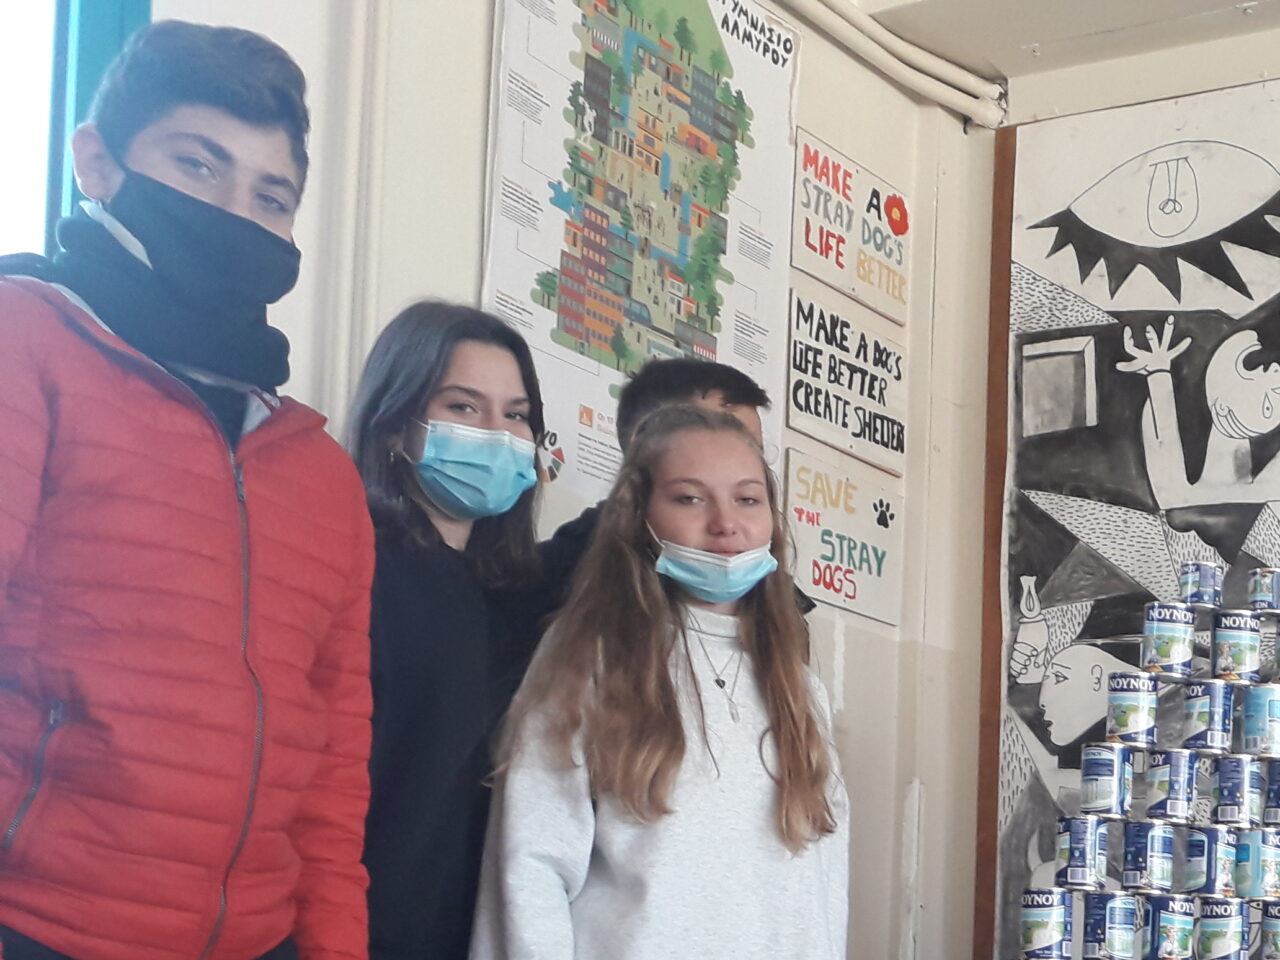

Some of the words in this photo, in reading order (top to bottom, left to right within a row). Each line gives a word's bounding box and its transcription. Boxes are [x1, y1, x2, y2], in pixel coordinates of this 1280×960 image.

[721, 12, 789, 68] ΑΛΜΥΡΟΥ
[802, 143, 853, 202] MAKE
[866, 188, 882, 221] A
[800, 177, 855, 233] STRAY
[862, 216, 904, 266] DOG'S
[804, 216, 846, 269] LIFE
[856, 248, 907, 305] BETTER
[796, 296, 850, 353] MAKE
[855, 332, 868, 363] A
[828, 354, 887, 407] BETTER
[792, 378, 851, 429] CREATE
[851, 406, 905, 454] SHELTER
[796, 466, 858, 515] SAVE
[793, 507, 822, 527] THE
[820, 528, 887, 578] STRAY
[812, 559, 857, 600] DOGS
[1149, 609, 1194, 622] NOYNOY
[1109, 679, 1155, 691] NOYNOY
[1186, 685, 1205, 697] NOY
[1169, 901, 1195, 913] NOYN
